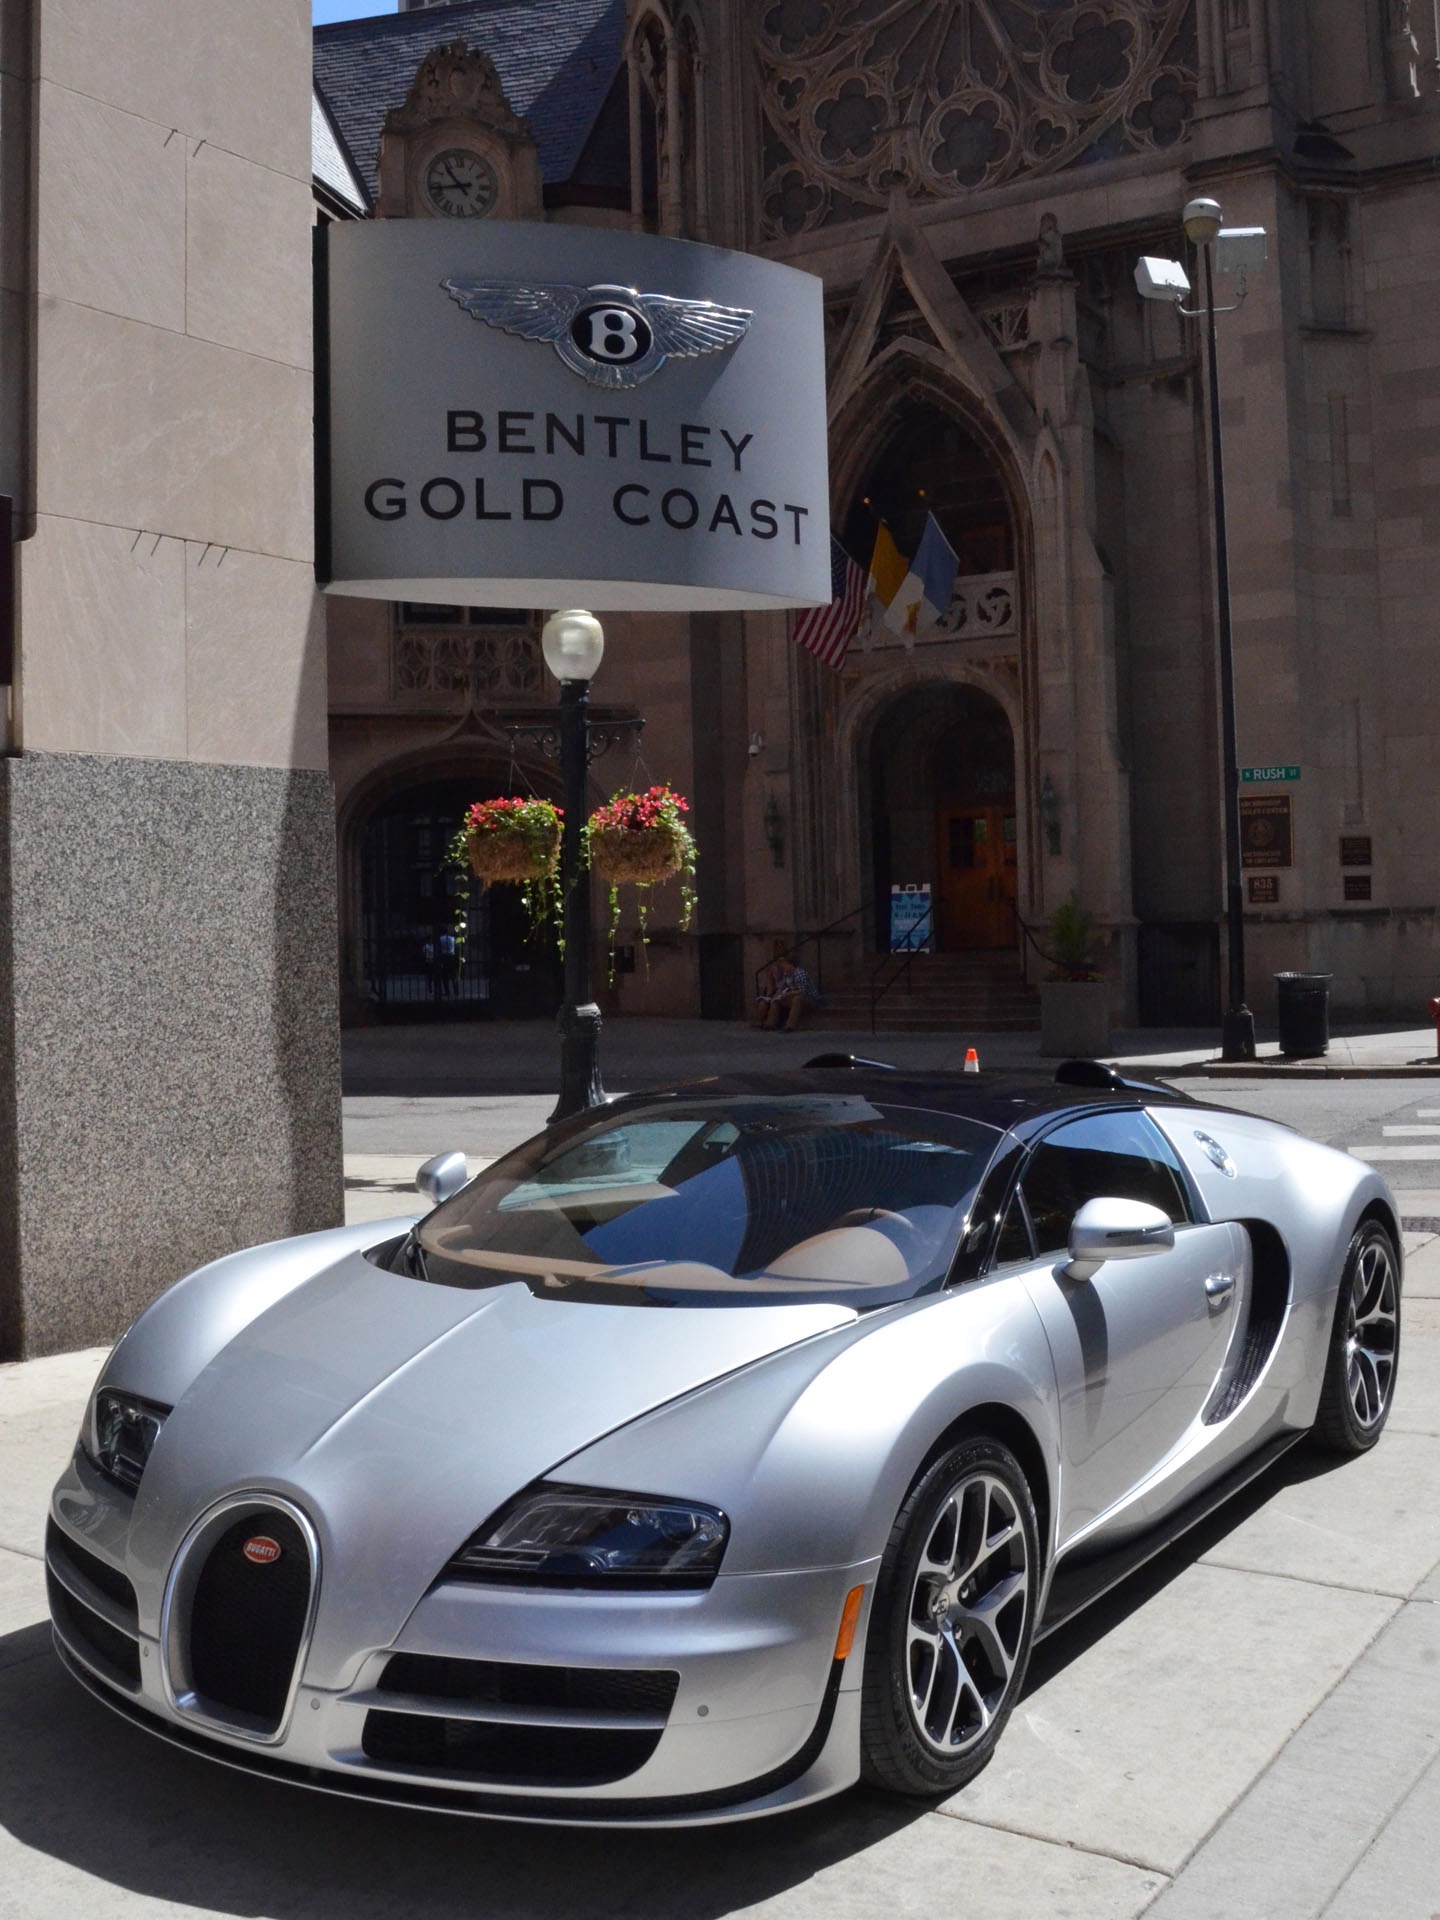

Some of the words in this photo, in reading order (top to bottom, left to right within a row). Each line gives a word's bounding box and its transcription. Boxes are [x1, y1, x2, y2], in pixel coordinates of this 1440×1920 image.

[589, 308, 638, 362] B
[446, 410, 755, 472] BENTLEY
[364, 476, 565, 522] GOLD
[612, 483, 809, 546] COAST
[1253, 768, 1286, 780] RUSH
[246, 1542, 277, 1558] BUGATTI
